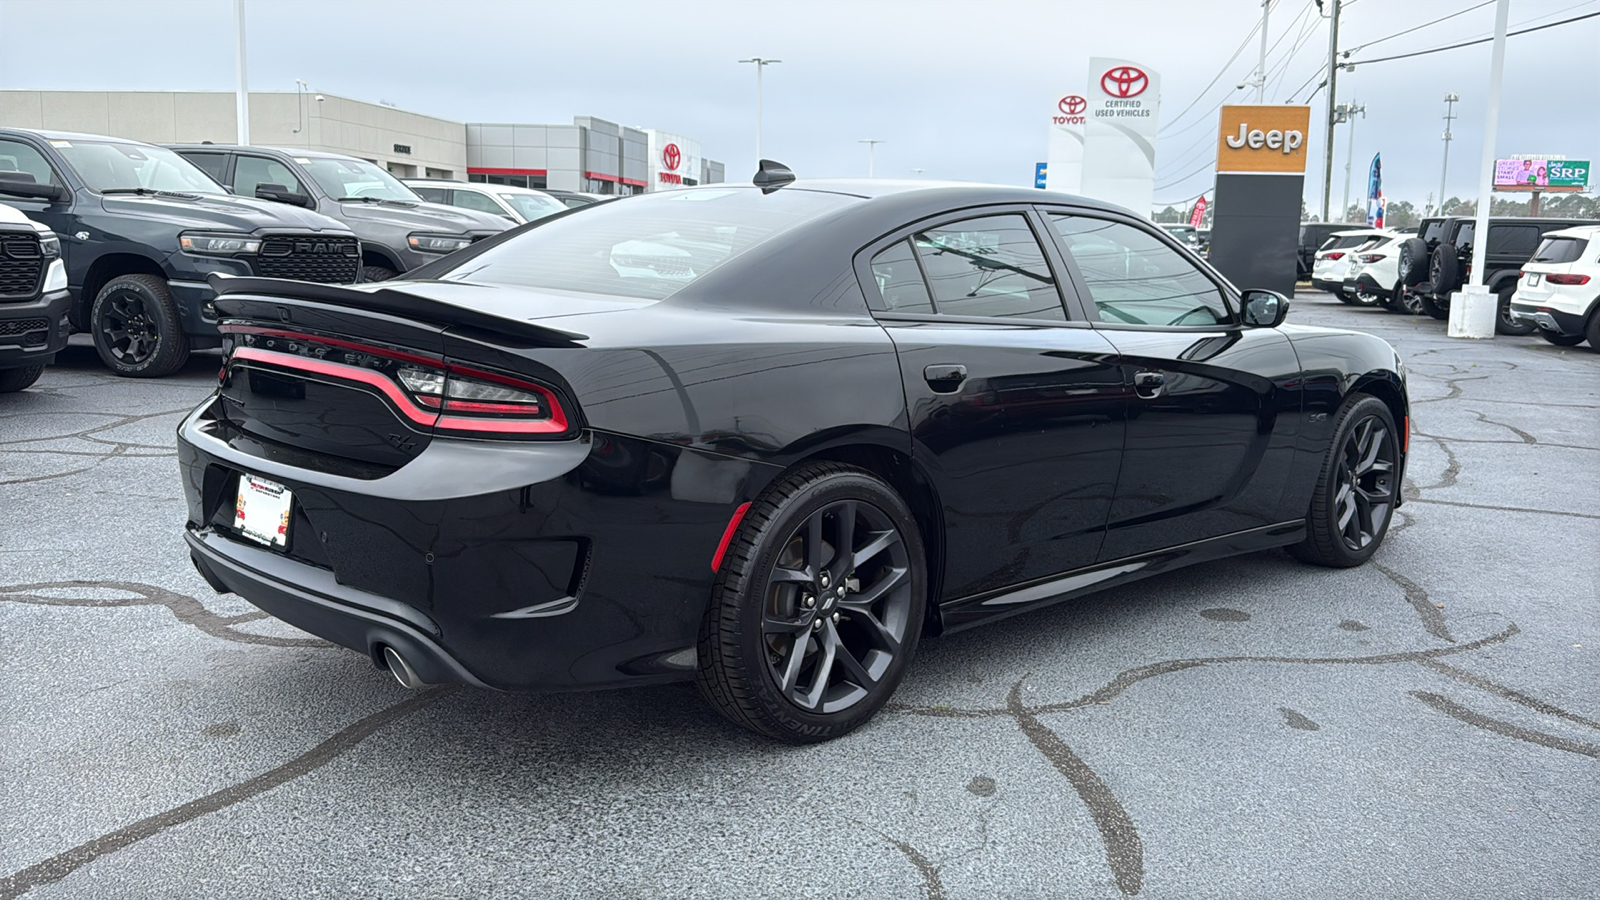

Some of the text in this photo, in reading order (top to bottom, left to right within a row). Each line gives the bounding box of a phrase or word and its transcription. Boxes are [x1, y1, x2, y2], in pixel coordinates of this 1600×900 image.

[1105, 100, 1141, 108] CERTIFIED
[1095, 109, 1150, 117] USED VEHICLES
[1226, 123, 1303, 154] Jeep
[1550, 168, 1586, 178] SRP
[296, 242, 342, 253] RAM
